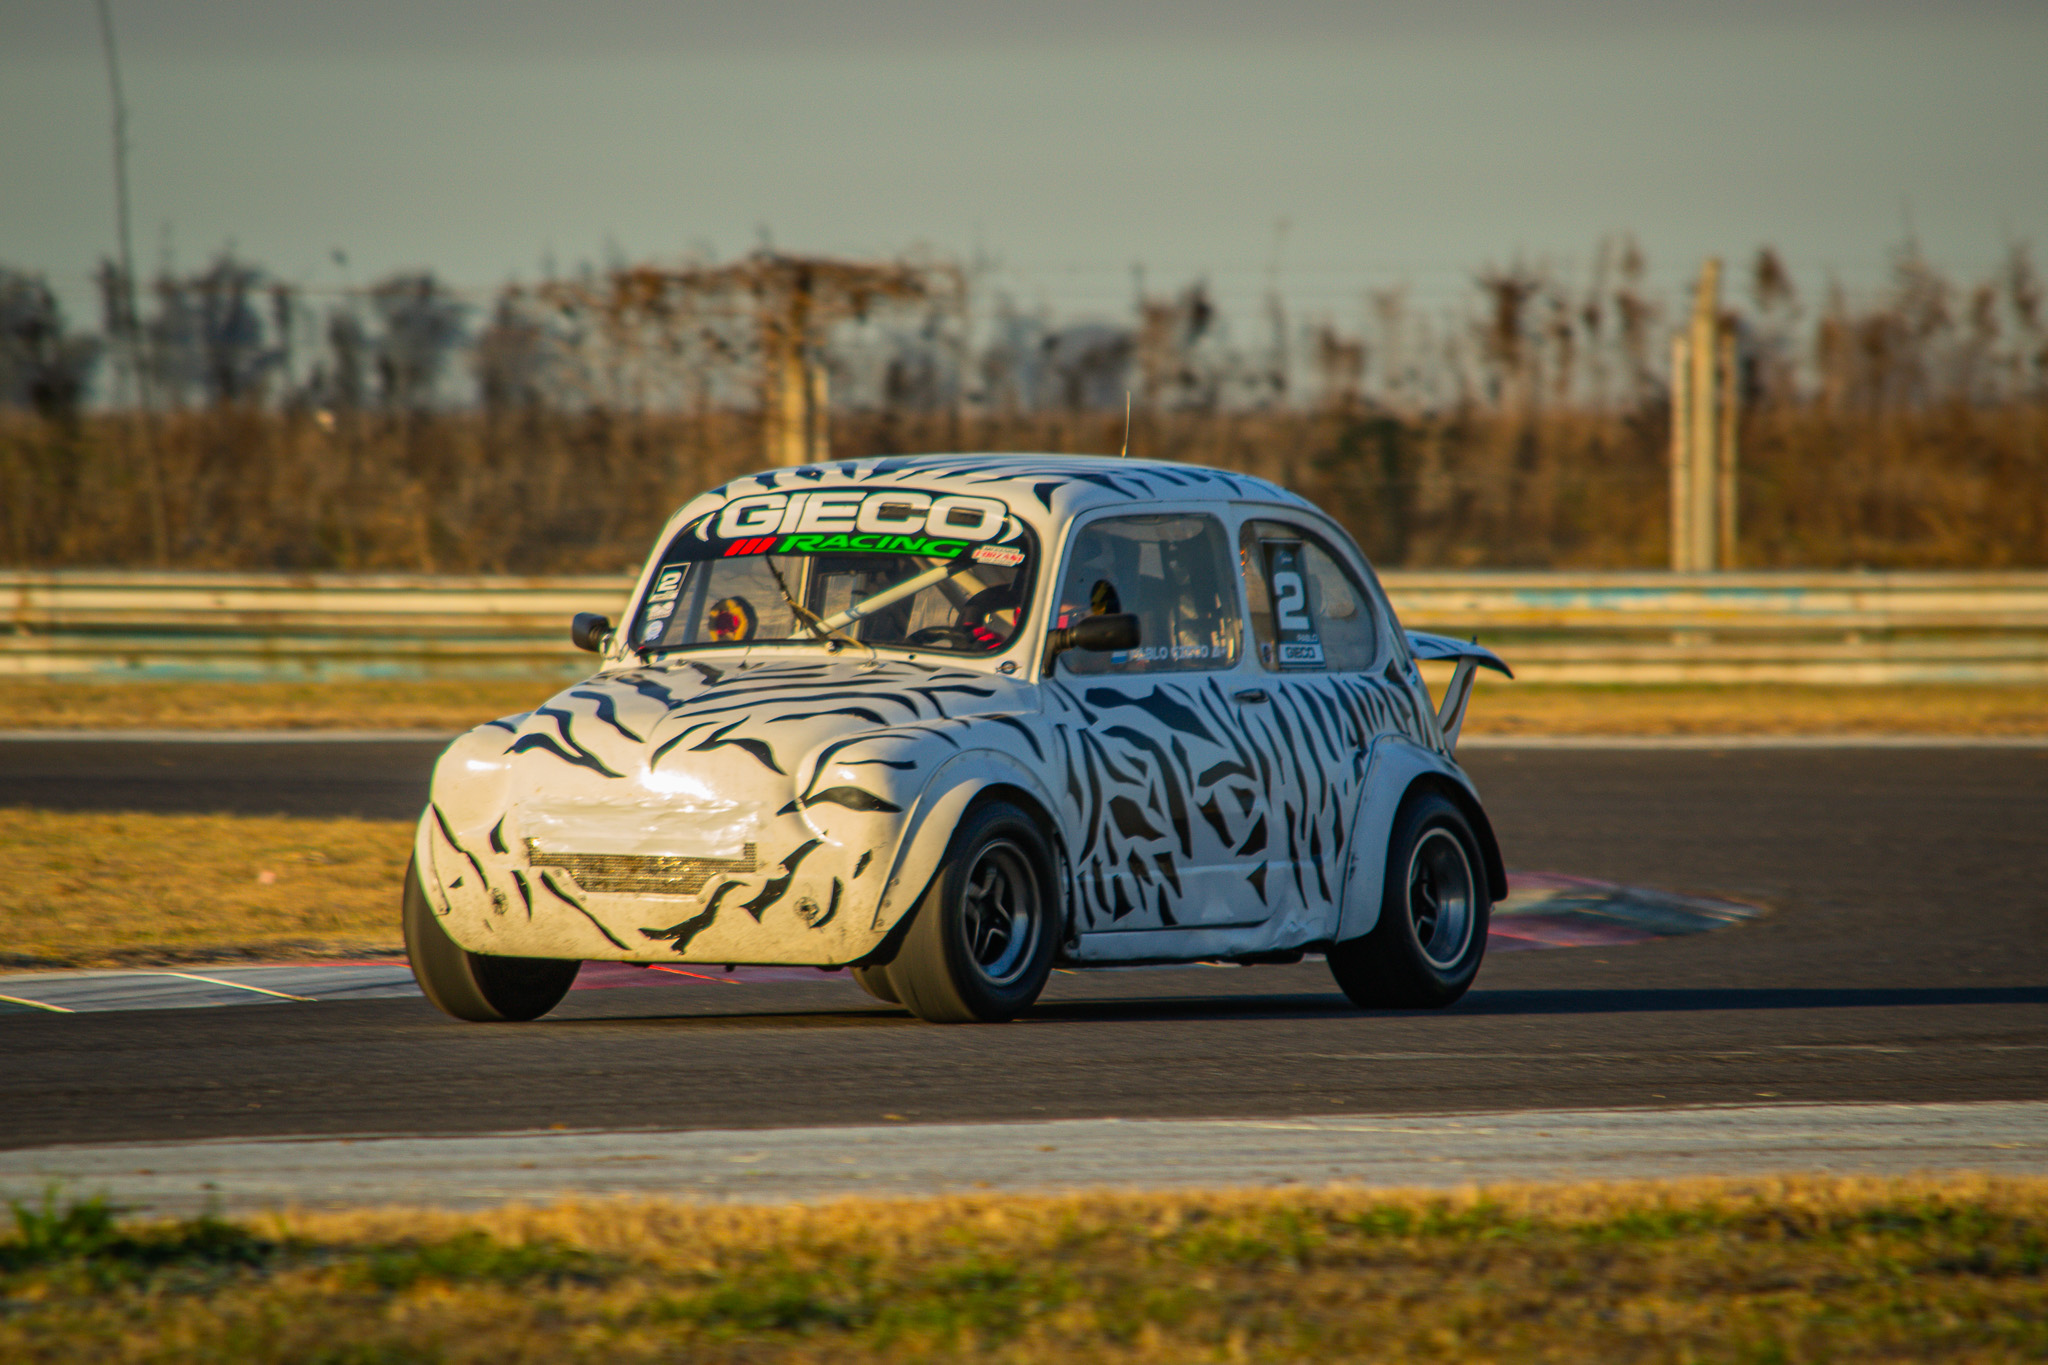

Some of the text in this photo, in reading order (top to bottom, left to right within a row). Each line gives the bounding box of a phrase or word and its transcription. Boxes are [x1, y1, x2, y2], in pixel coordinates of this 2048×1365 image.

[717, 492, 1008, 541] GIECO
[777, 534, 970, 558] RACING
[657, 571, 682, 592] 2
[1274, 571, 1311, 629] 2
[1130, 645, 1168, 660] PABLO
[1285, 647, 1316, 659] GIECO
